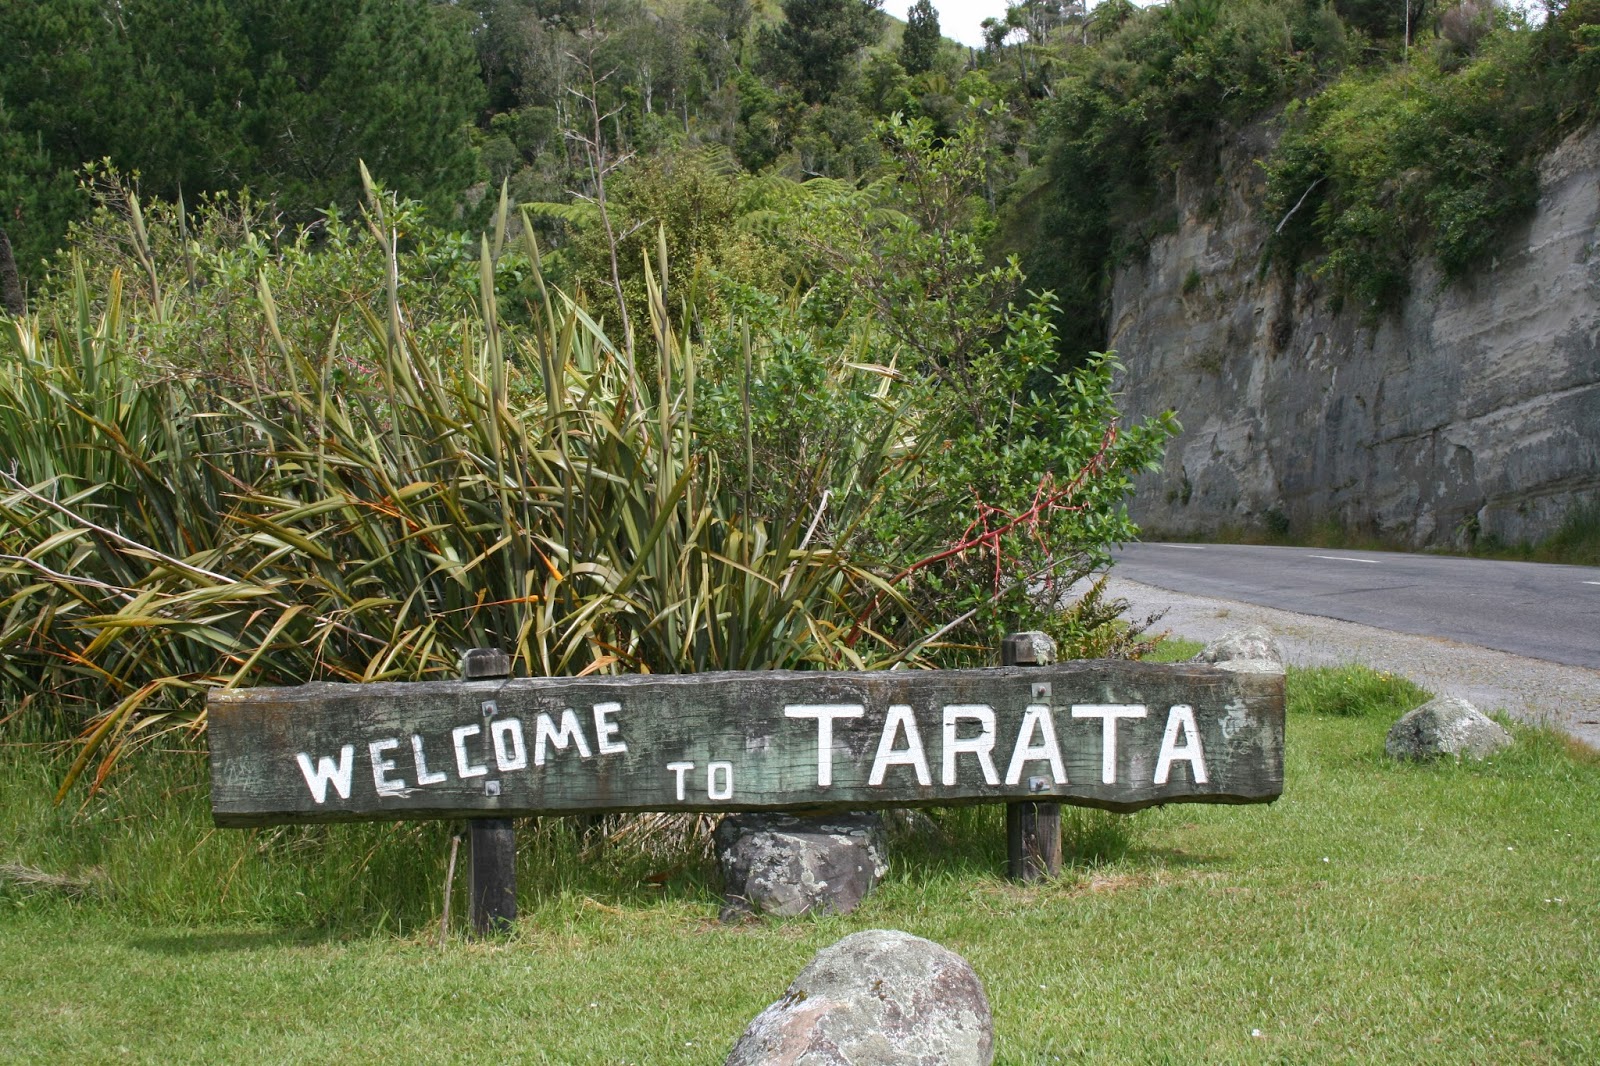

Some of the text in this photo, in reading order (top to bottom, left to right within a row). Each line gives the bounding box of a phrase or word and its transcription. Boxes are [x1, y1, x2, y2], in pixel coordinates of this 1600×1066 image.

[296, 701, 1209, 804] WELCOME TO TARATA
